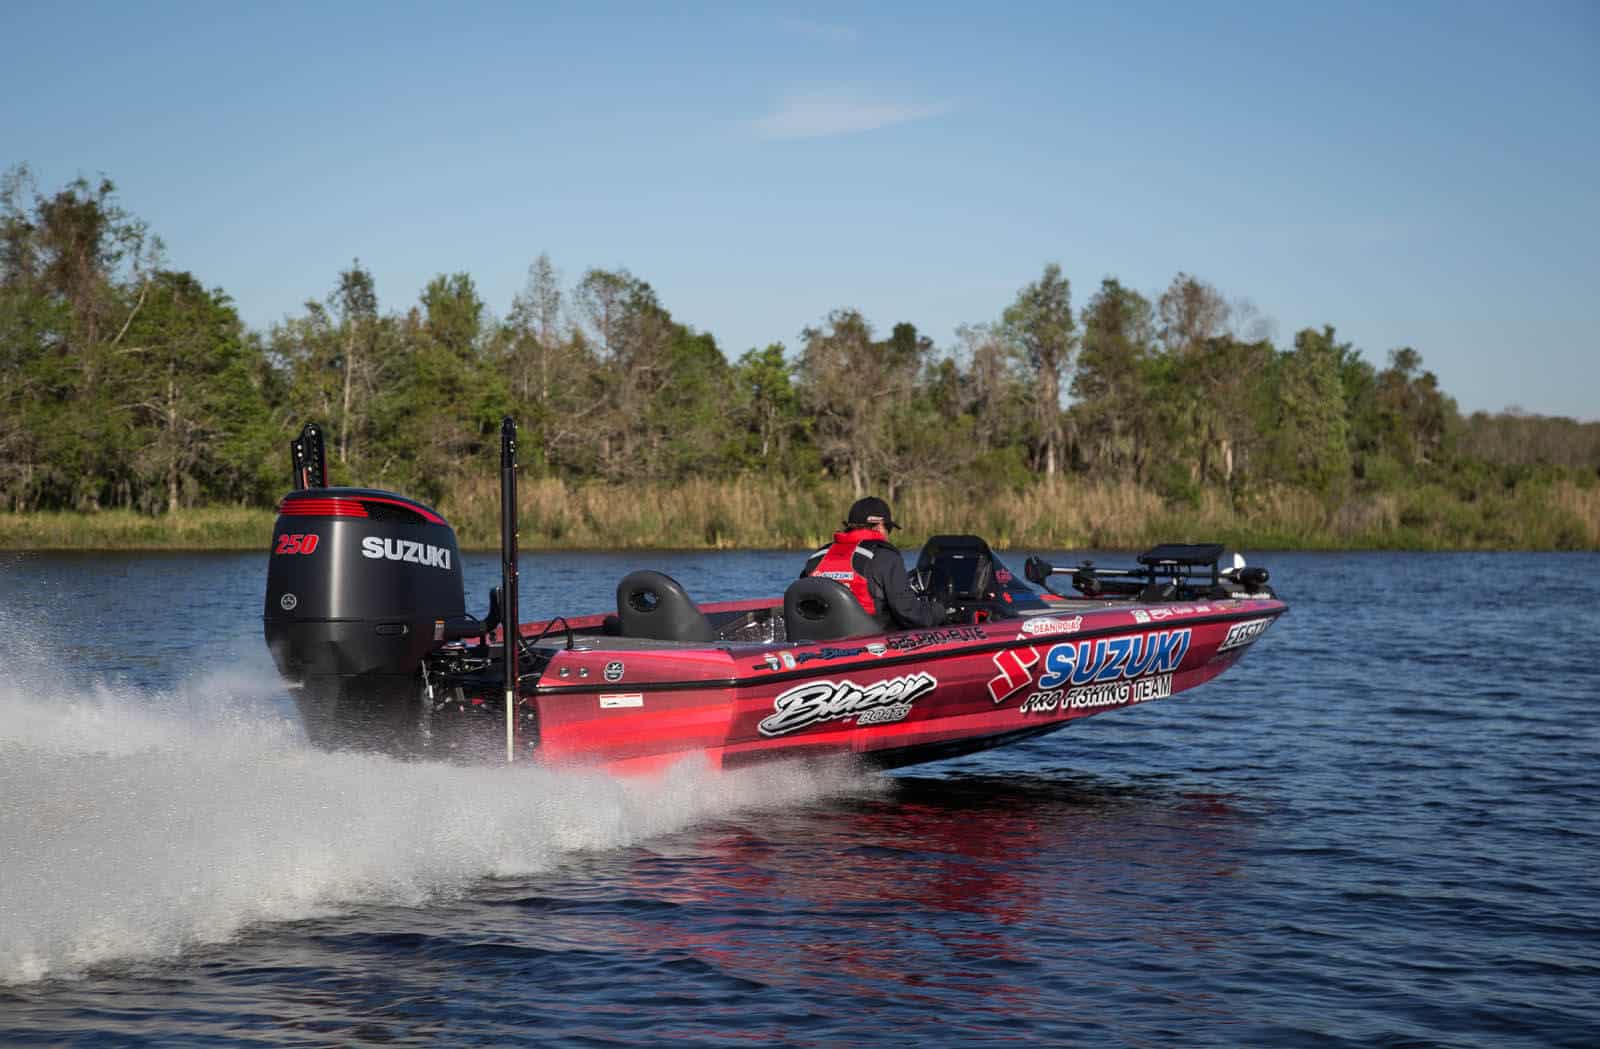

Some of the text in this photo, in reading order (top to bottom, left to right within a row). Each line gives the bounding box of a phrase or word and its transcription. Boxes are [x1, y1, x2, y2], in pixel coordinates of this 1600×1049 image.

[275, 534, 319, 555] 250
[362, 536, 451, 570] SUZUKI
[1038, 628, 1192, 690] SUZUKI
[758, 671, 937, 736] Blazer
[1020, 673, 1172, 713] PRO FISHING TEAM
[857, 704, 912, 725] BOATS
